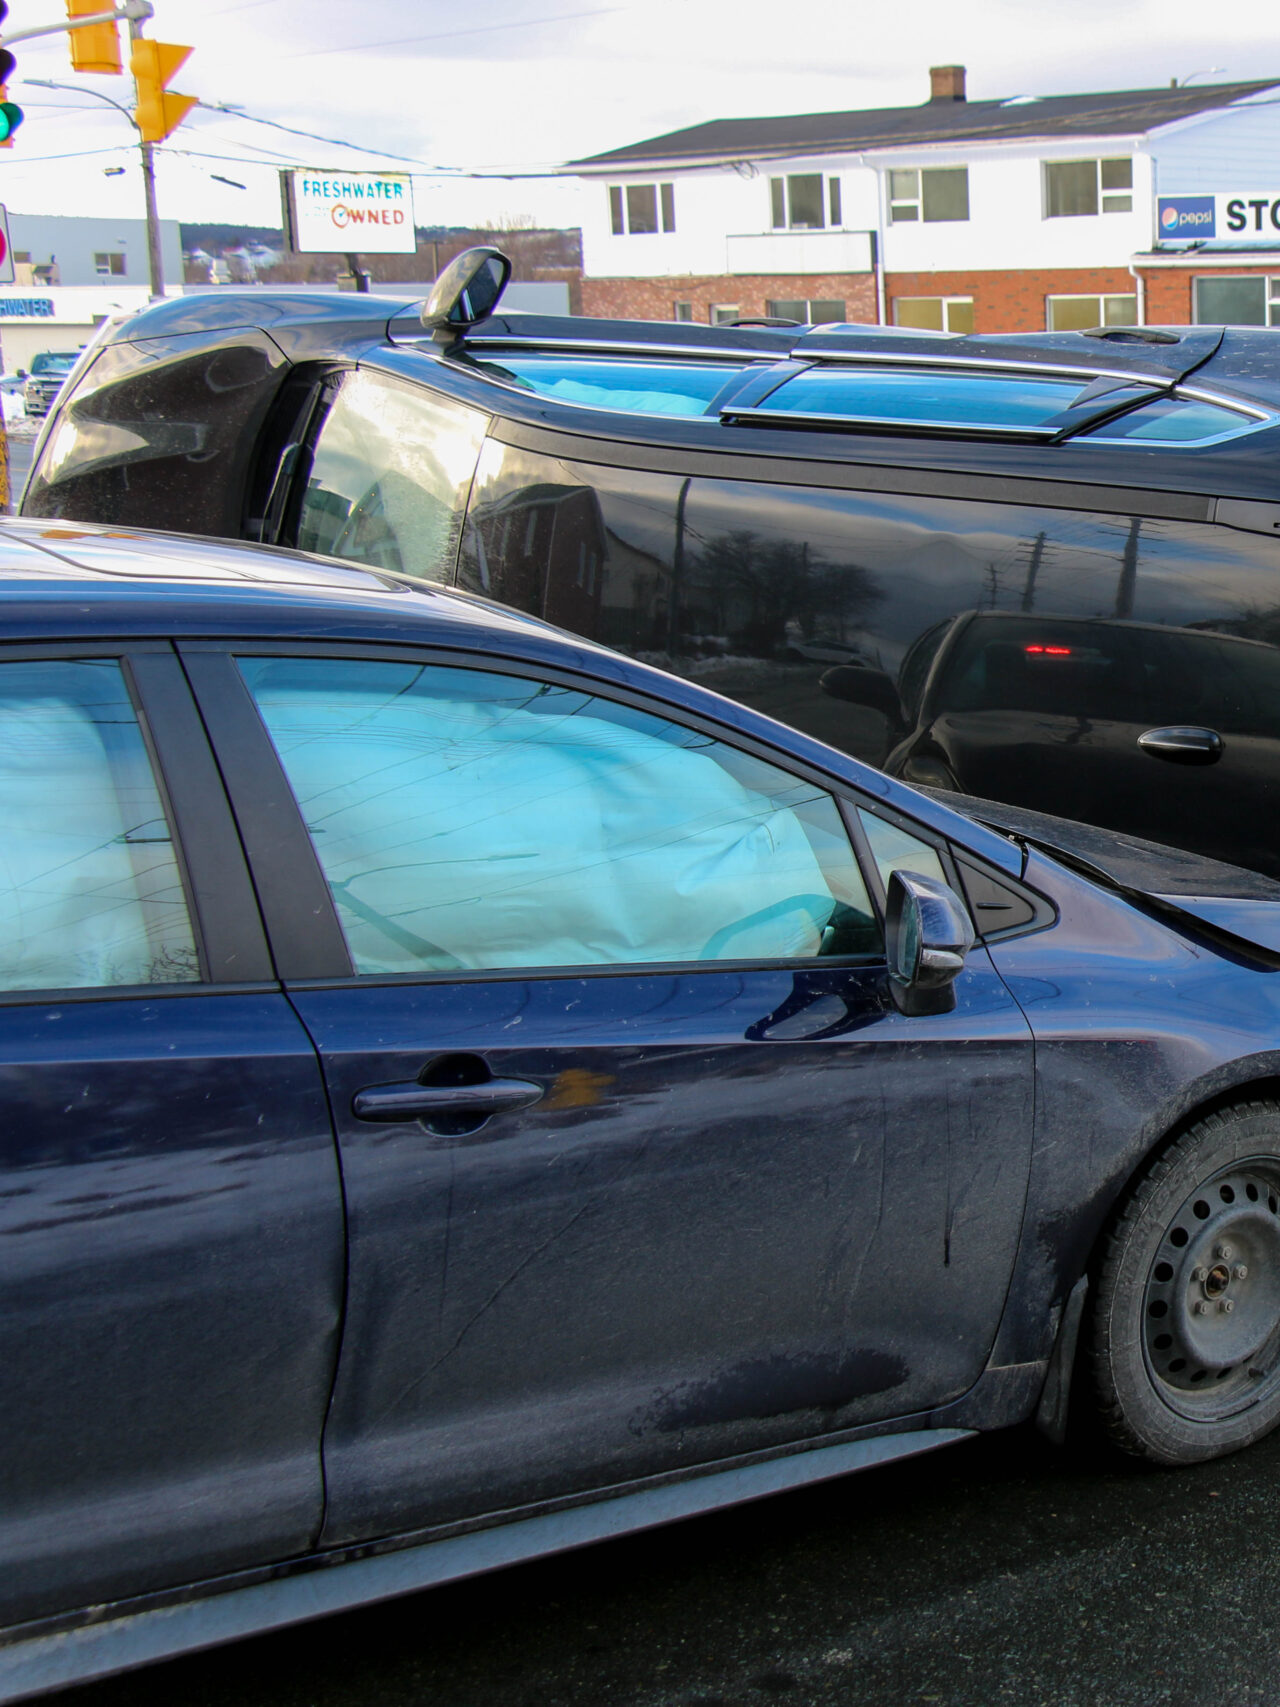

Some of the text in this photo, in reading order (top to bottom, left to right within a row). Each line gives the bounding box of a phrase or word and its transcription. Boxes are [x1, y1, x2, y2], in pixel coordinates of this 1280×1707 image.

[303, 179, 403, 199] FRESHWATER
[331, 203, 405, 229] OWNED
[1179, 209, 1213, 226] pepsi
